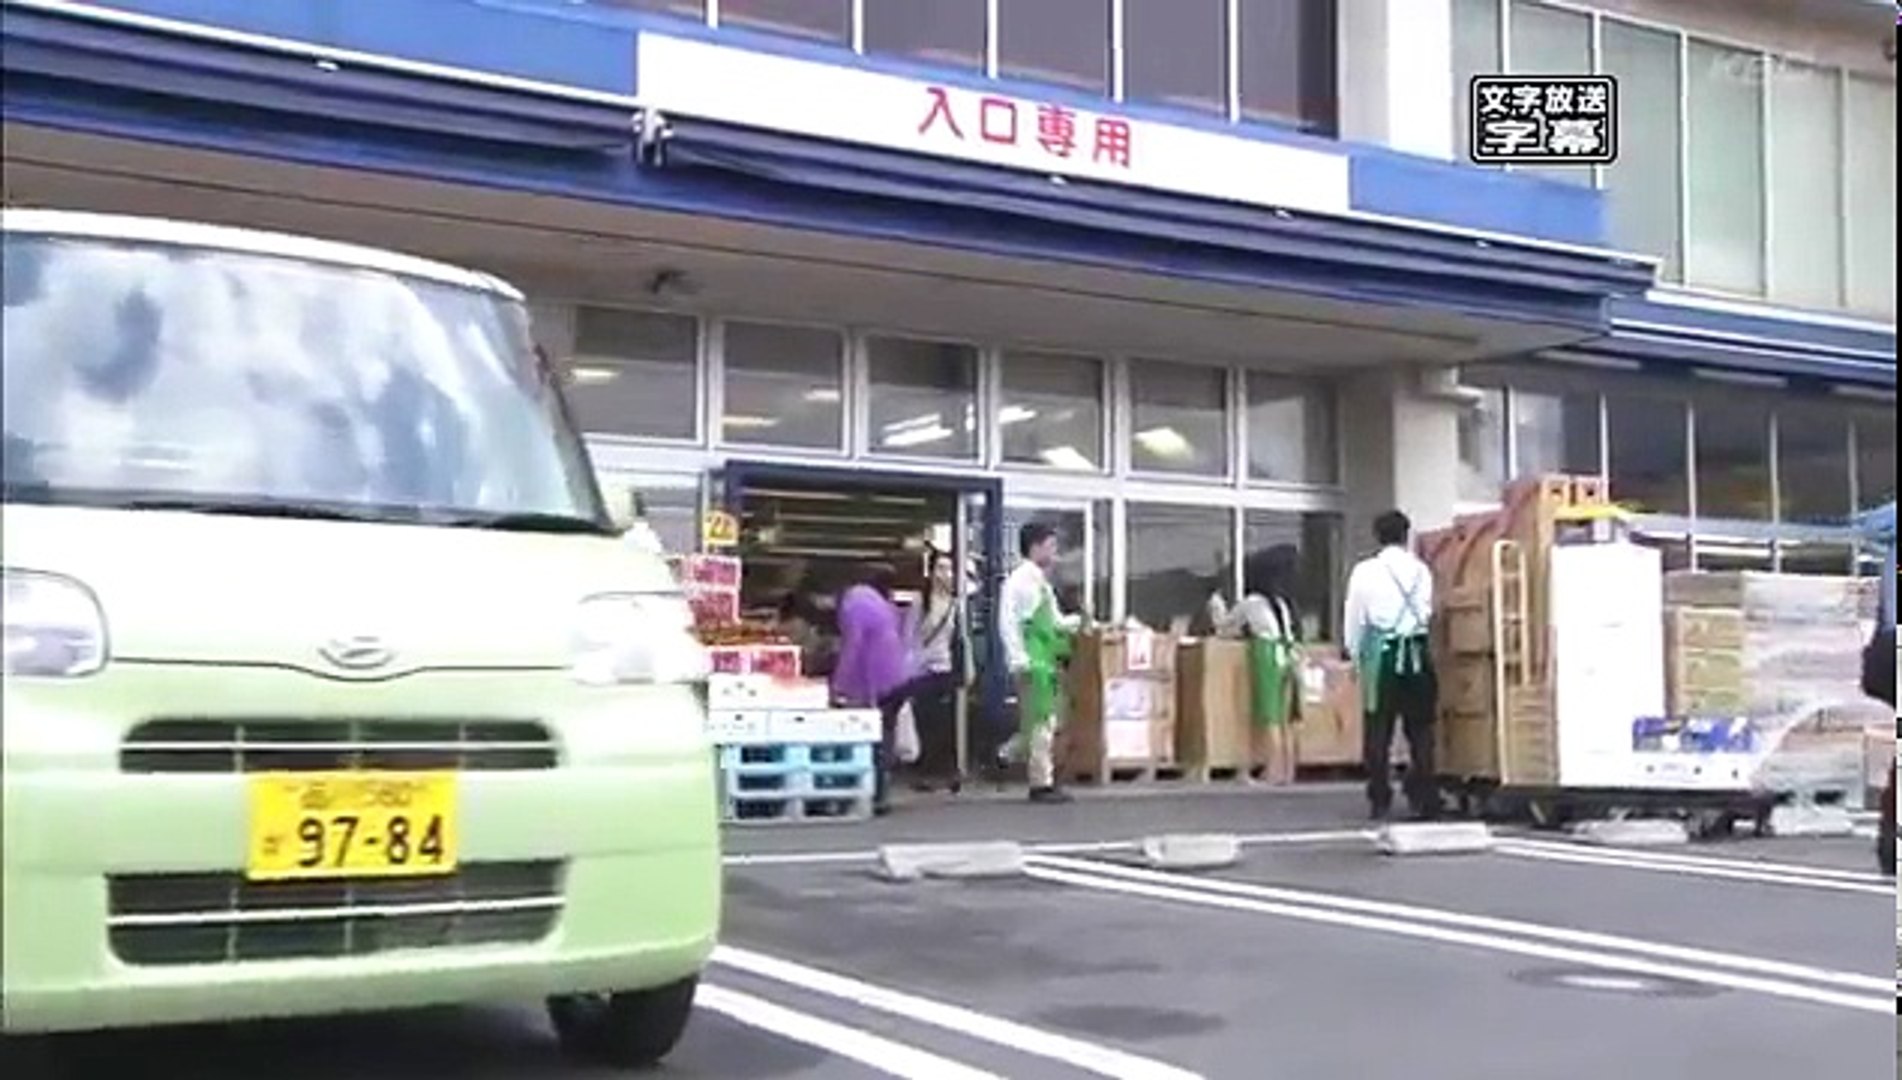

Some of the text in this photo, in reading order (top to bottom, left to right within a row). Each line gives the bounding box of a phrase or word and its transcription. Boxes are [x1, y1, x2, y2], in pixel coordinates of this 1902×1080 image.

[917, 86, 1130, 168] 入口専用
[296, 814, 444, 869] 97-84
